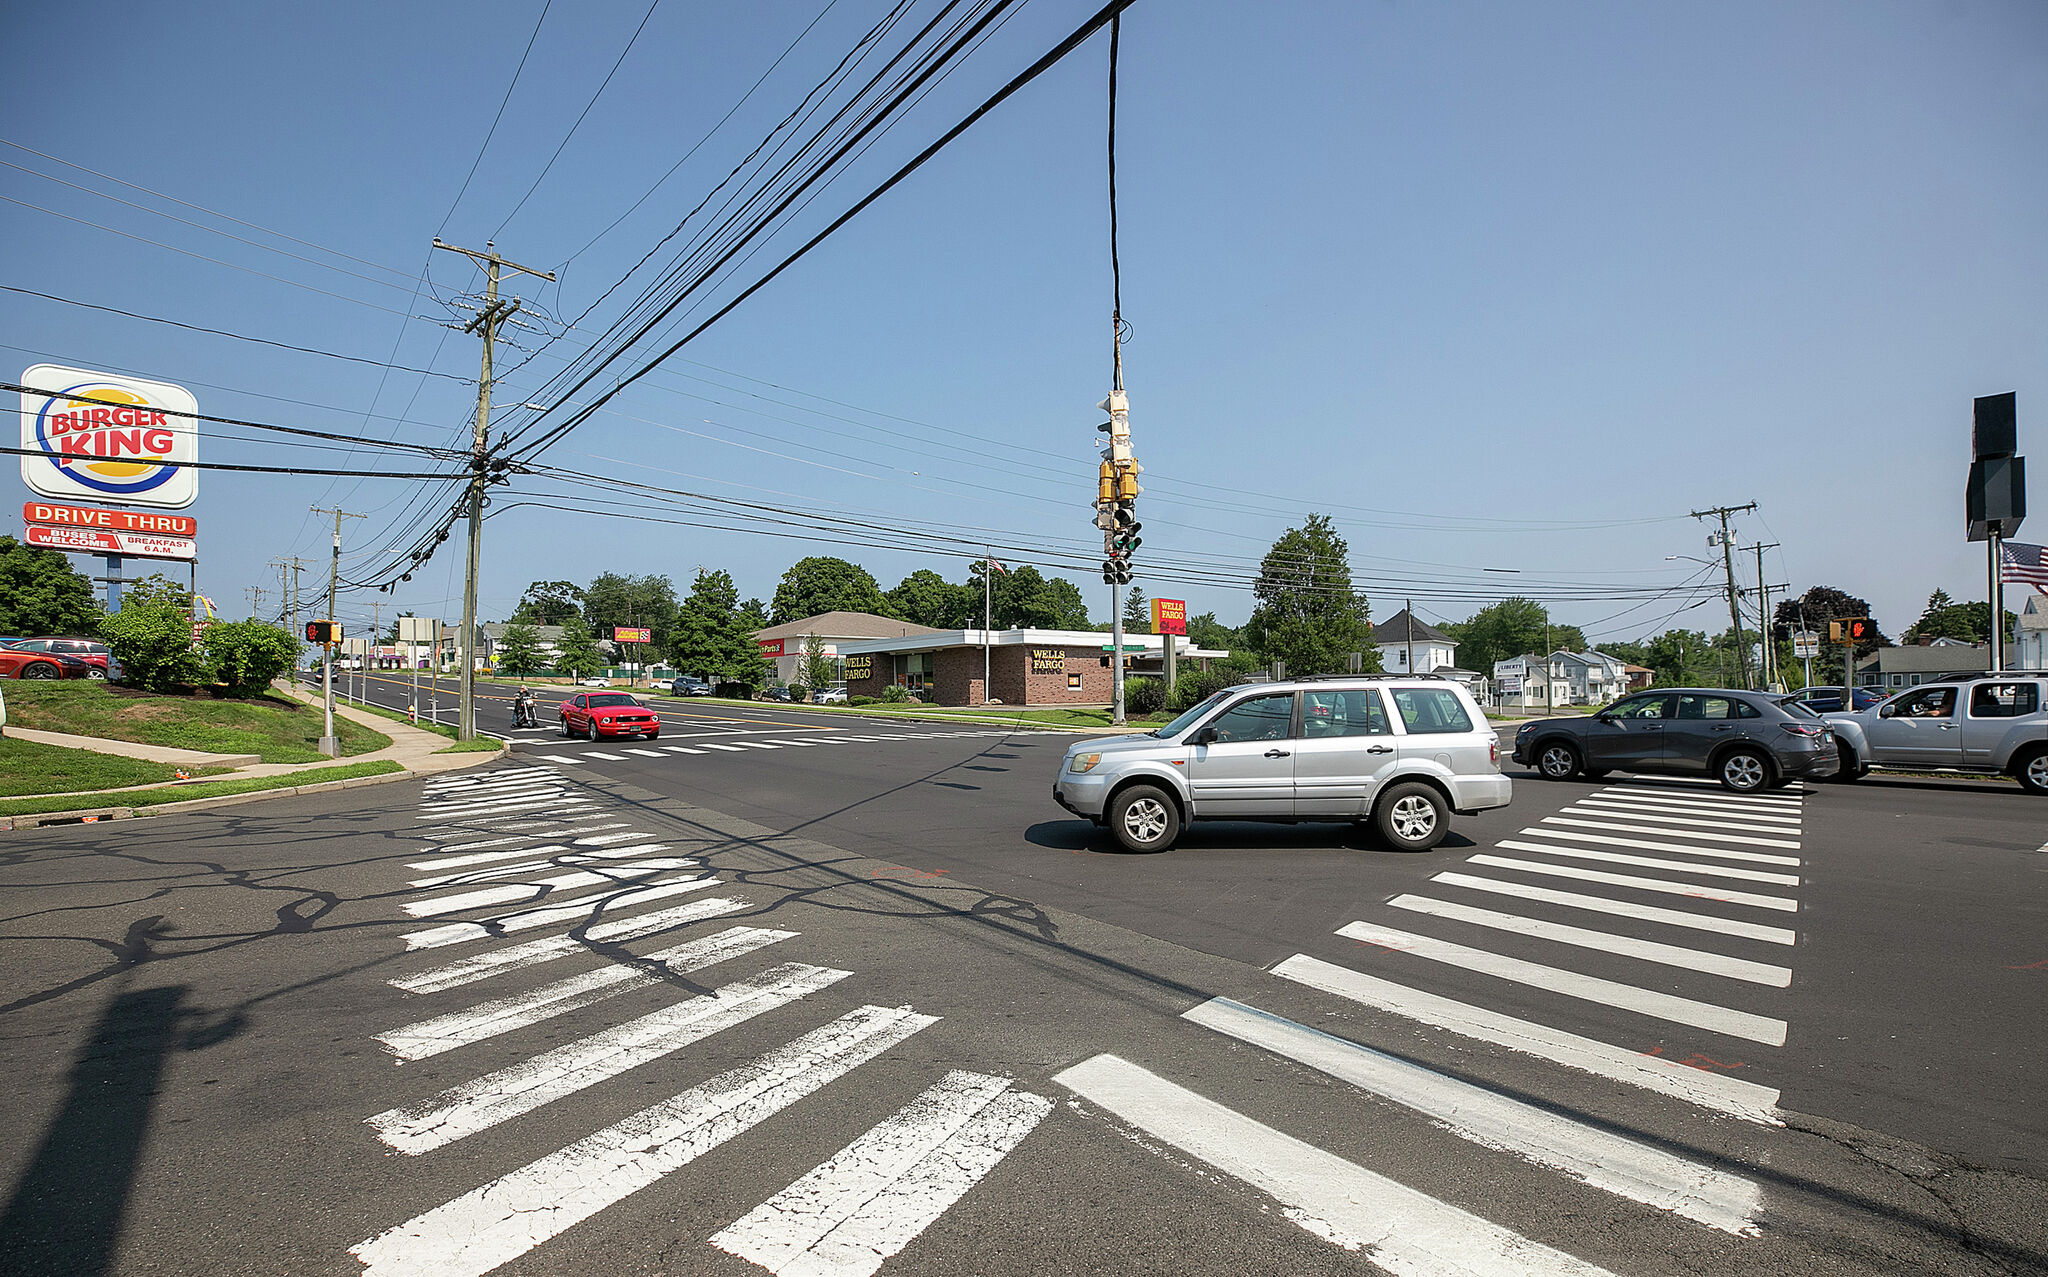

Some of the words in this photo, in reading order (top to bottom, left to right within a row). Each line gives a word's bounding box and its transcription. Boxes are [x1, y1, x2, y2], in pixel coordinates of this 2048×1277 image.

[52, 408, 167, 435] BURGER
[61, 429, 173, 465] KING
[35, 506, 111, 526] DRIVE
[123, 514, 187, 532] THRU
[50, 529, 97, 540] BUSES
[38, 534, 110, 548] WELCOME
[127, 536, 189, 548] BREAKFAST
[1161, 601, 1184, 611] WELLS
[1161, 610, 1184, 620] FARGO
[1033, 649, 1065, 659] WELLS
[844, 656, 872, 668] WELLS
[1033, 659, 1064, 669] FARGO
[844, 668, 871, 680] FARGO
